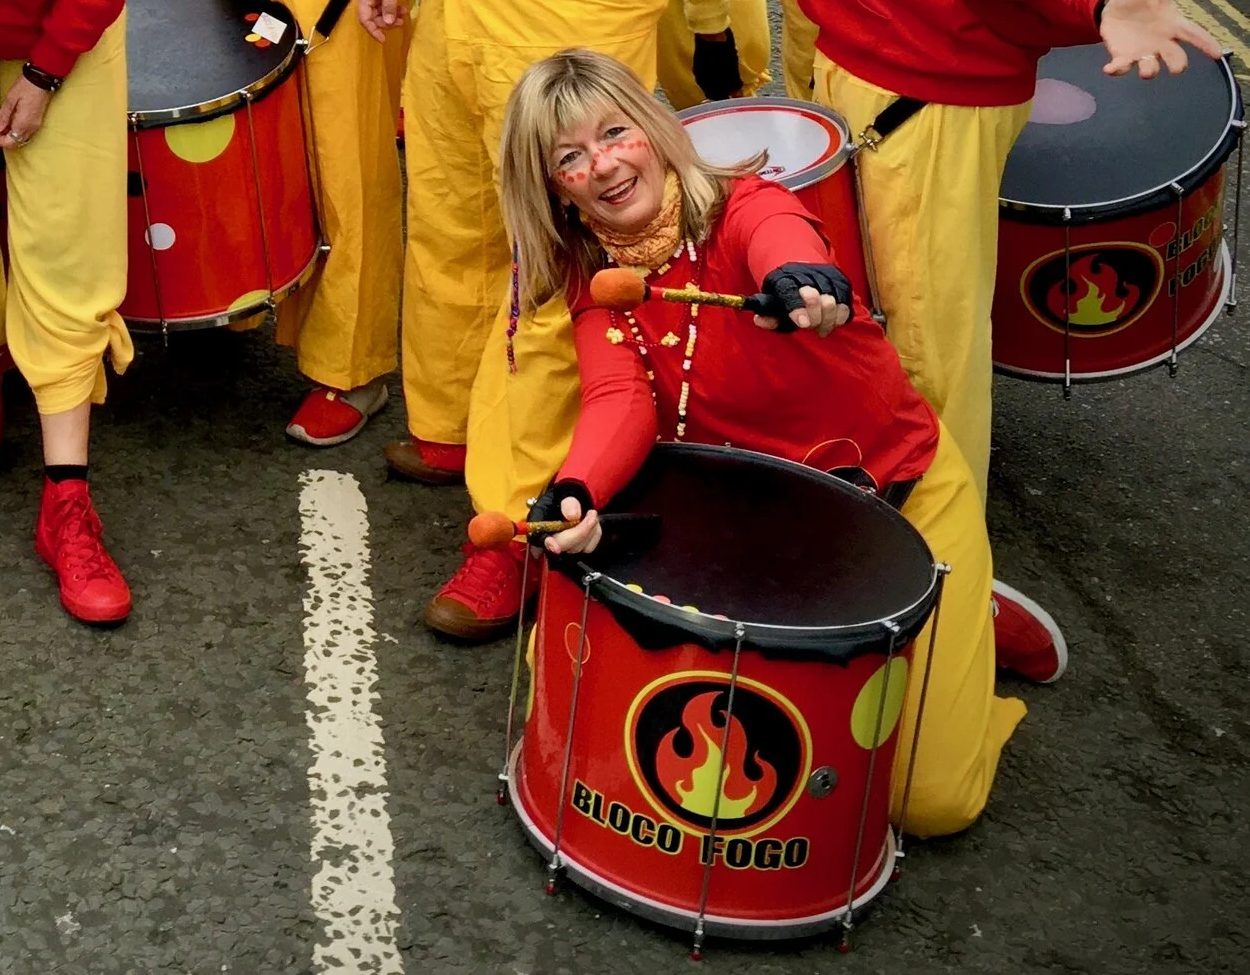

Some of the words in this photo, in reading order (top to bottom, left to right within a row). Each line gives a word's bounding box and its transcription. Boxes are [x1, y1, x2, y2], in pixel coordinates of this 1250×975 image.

[1166, 205, 1218, 261] BLOC
[571, 779, 684, 855] BLOCO
[699, 833, 811, 871] FOGO
